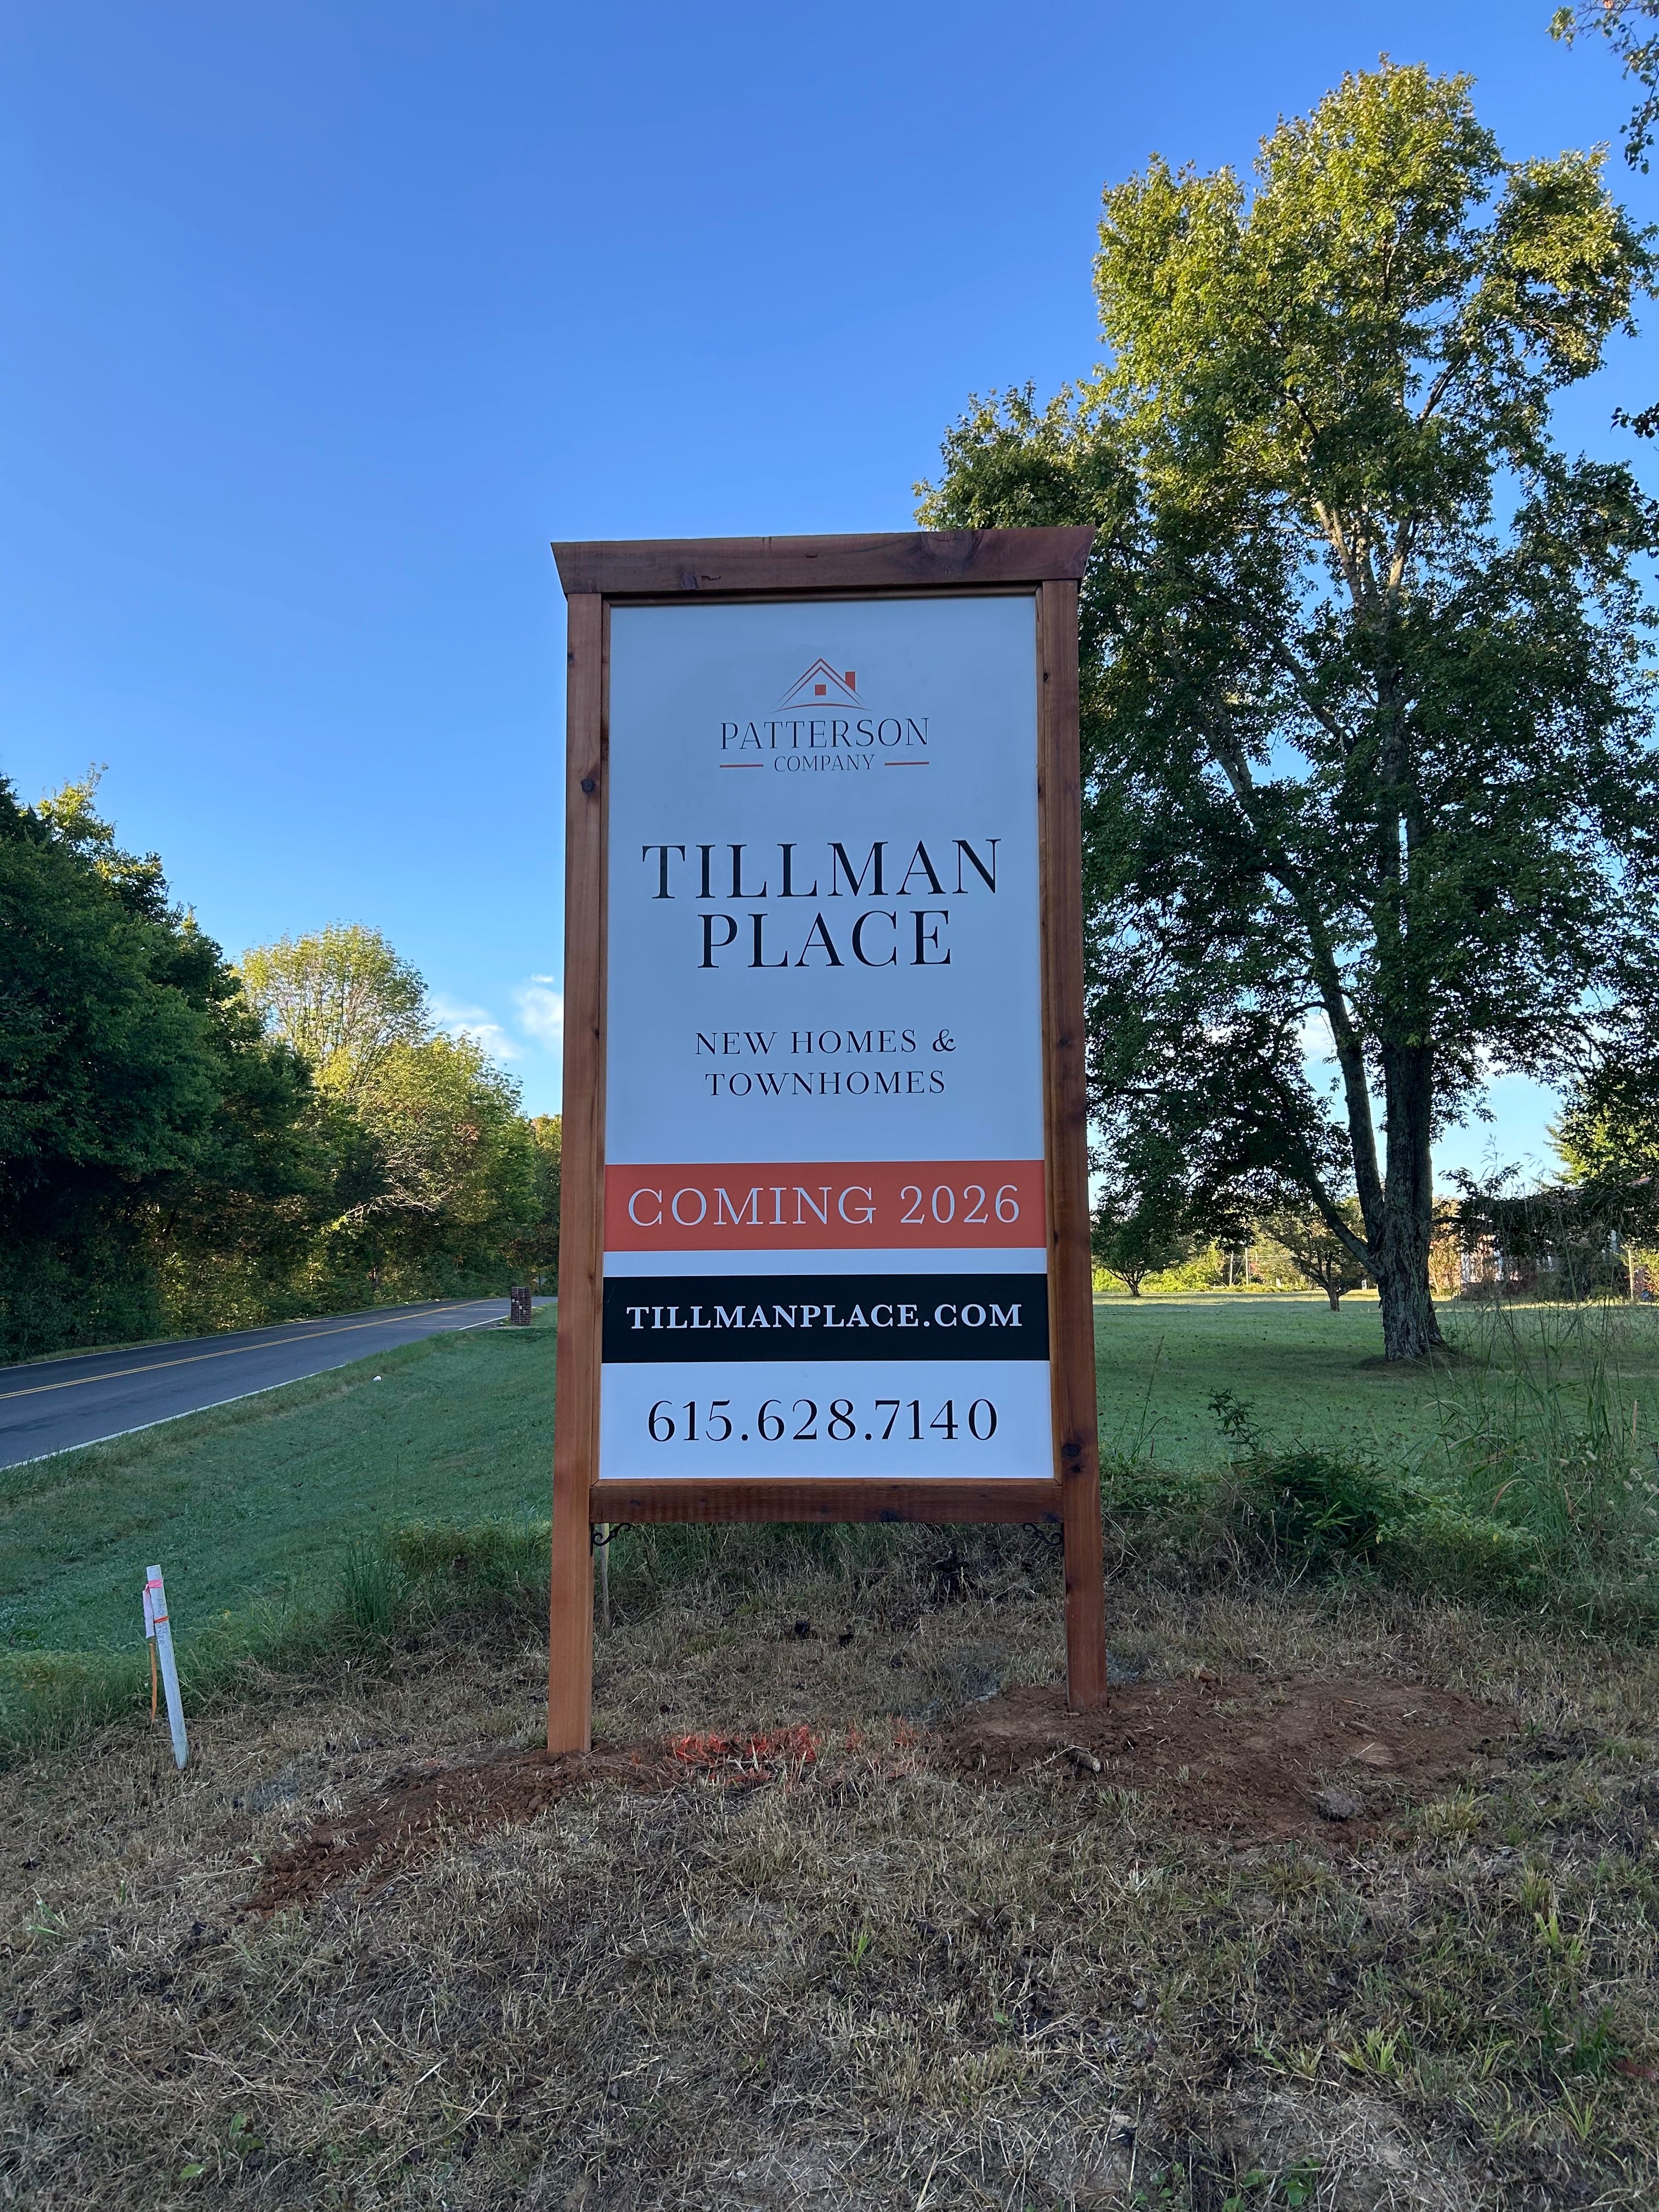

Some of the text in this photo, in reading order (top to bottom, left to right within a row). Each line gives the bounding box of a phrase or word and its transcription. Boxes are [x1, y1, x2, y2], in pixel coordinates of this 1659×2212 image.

[720, 717, 929, 751] PATTERSON
[774, 754, 875, 773] COMPANY
[642, 838, 1002, 900] TILLMAN
[697, 909, 951, 969] PLACE
[695, 1029, 957, 1056] NEW HOMES &
[705, 1070, 945, 1097] TOWNHOMES
[628, 1184, 1020, 1227] COMING 2026
[626, 1303, 1023, 1330] TILLMANPLACE.COM
[647, 1398, 998, 1443] 615.628.7140
